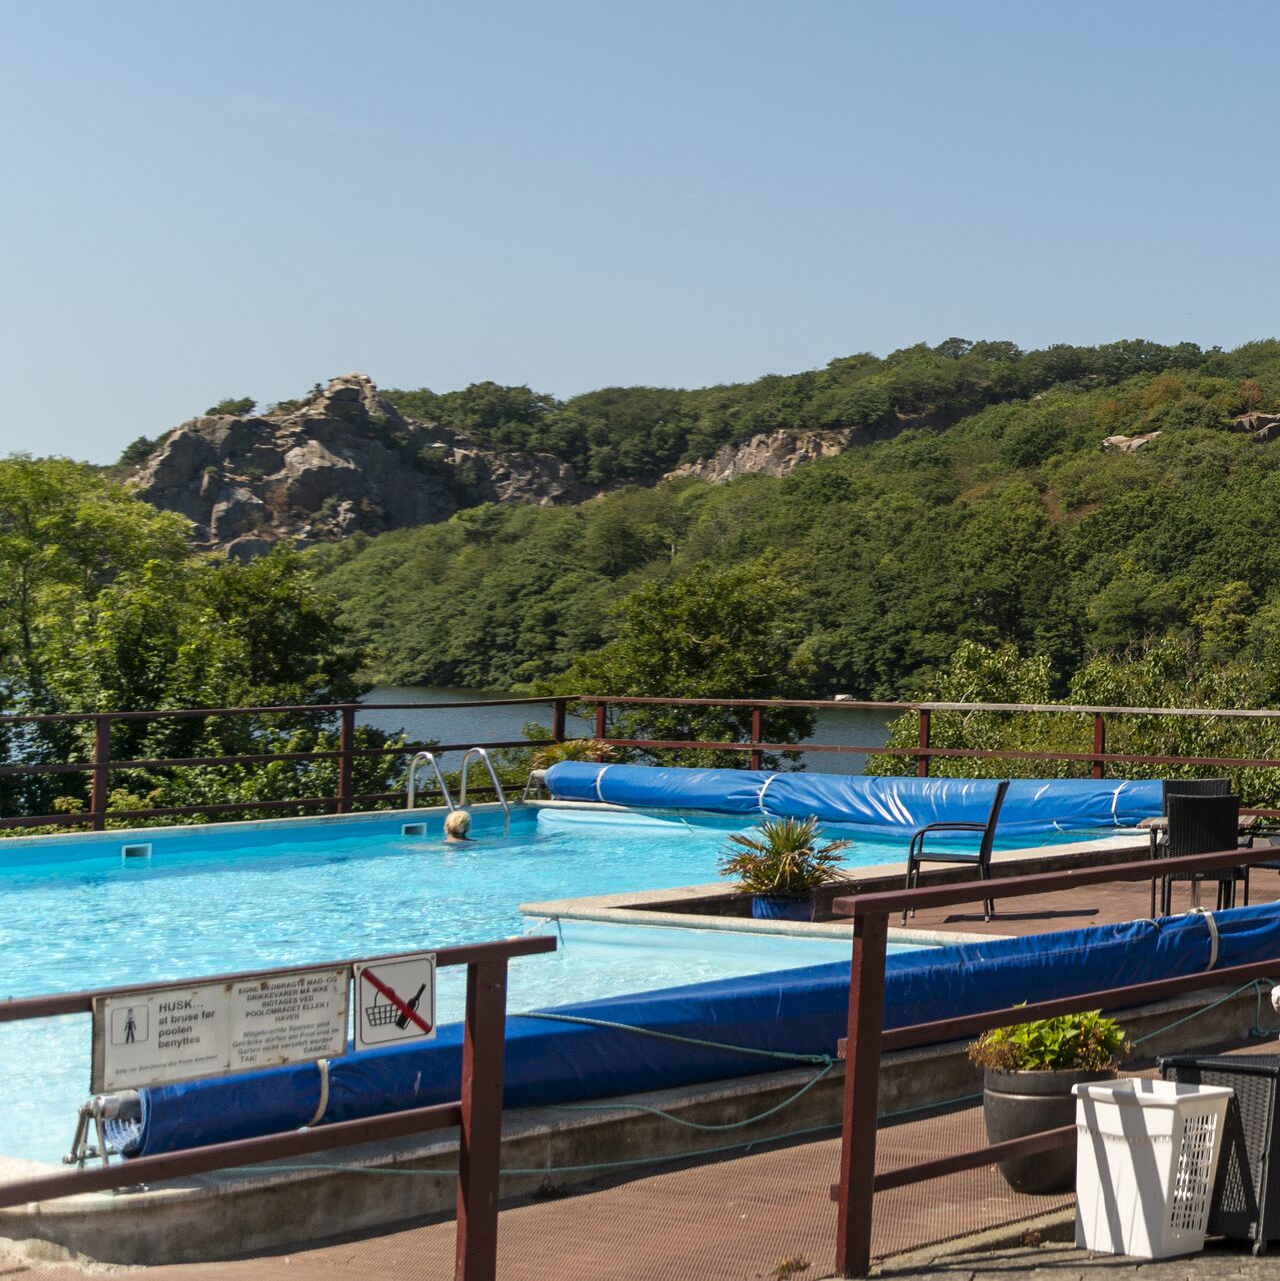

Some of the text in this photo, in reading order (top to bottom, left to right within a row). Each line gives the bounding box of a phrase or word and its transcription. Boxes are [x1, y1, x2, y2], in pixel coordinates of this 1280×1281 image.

[158, 1009, 216, 1026] at bruse før
[158, 1025, 193, 1039] poolen
[158, 1036, 201, 1050] benyttes
